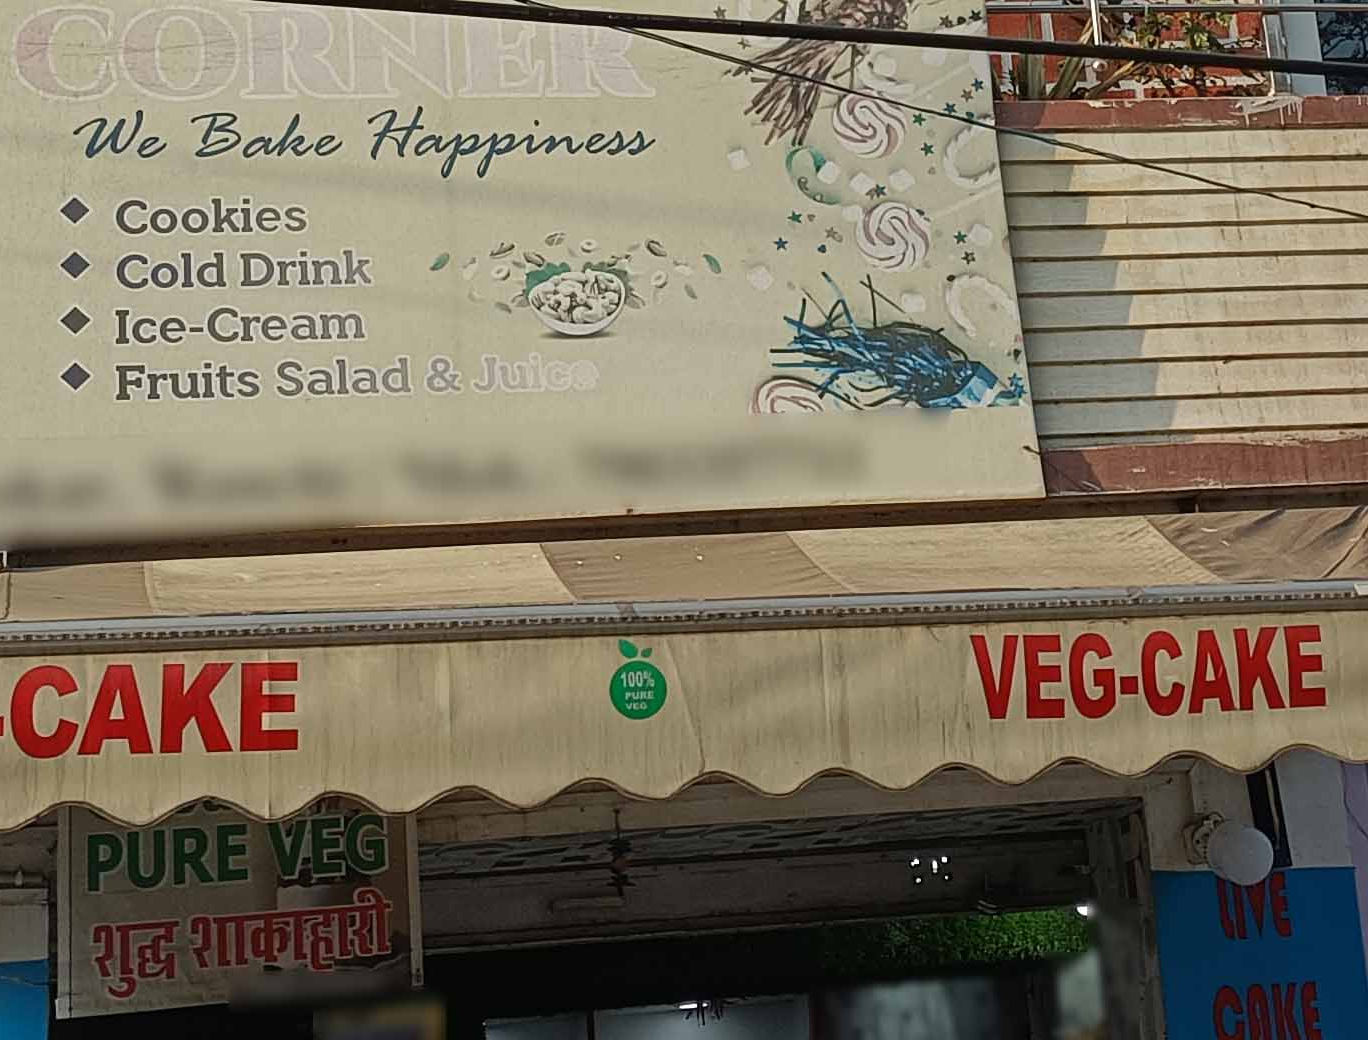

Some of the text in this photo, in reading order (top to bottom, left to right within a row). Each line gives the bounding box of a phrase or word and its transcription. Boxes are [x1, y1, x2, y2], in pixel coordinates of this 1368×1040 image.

[13, 3, 656, 103] CORNER
[73, 106, 656, 179] We Bake Happiness
[113, 196, 309, 236] Cookies
[114, 249, 373, 290] Cold Drink
[114, 307, 366, 347] Ice-Cream
[114, 353, 600, 401] Fruits Salad & Juice
[620, 670, 655, 689] 100%
[625, 690, 655, 701] PURE
[969, 624, 1326, 722] VEG-CAKE
[87, 814, 389, 892] PURE VEG
[91, 887, 392, 998] शुद्ध शाकाहारी
